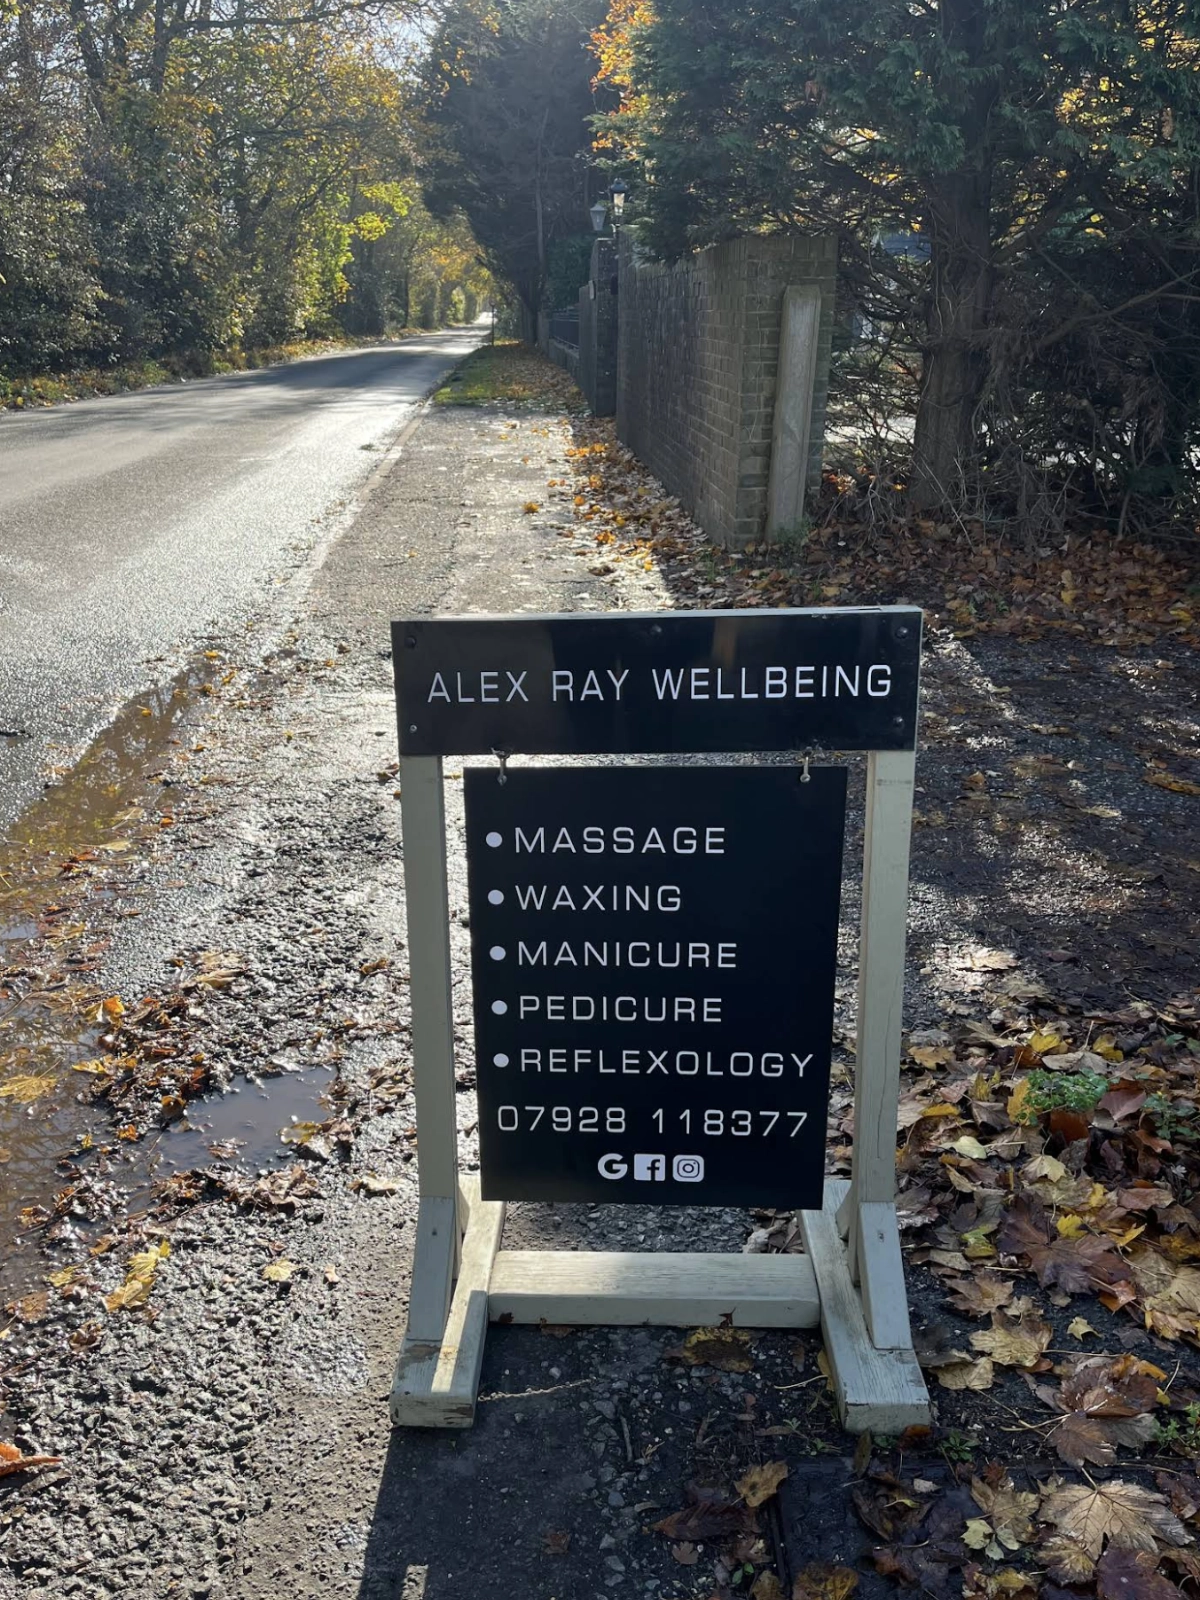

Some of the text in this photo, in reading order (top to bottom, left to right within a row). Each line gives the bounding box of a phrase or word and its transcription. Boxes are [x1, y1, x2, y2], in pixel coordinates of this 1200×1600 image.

[426, 664, 892, 703] ALEX RAY WELLBEING
[514, 826, 726, 854] MASSAGE
[515, 885, 682, 912] WAXING
[517, 941, 737, 968] MANICURE
[519, 995, 722, 1022] PEDICURE
[520, 1049, 814, 1078] REFLEXOLOGY
[497, 1105, 808, 1137] 07928 118377
